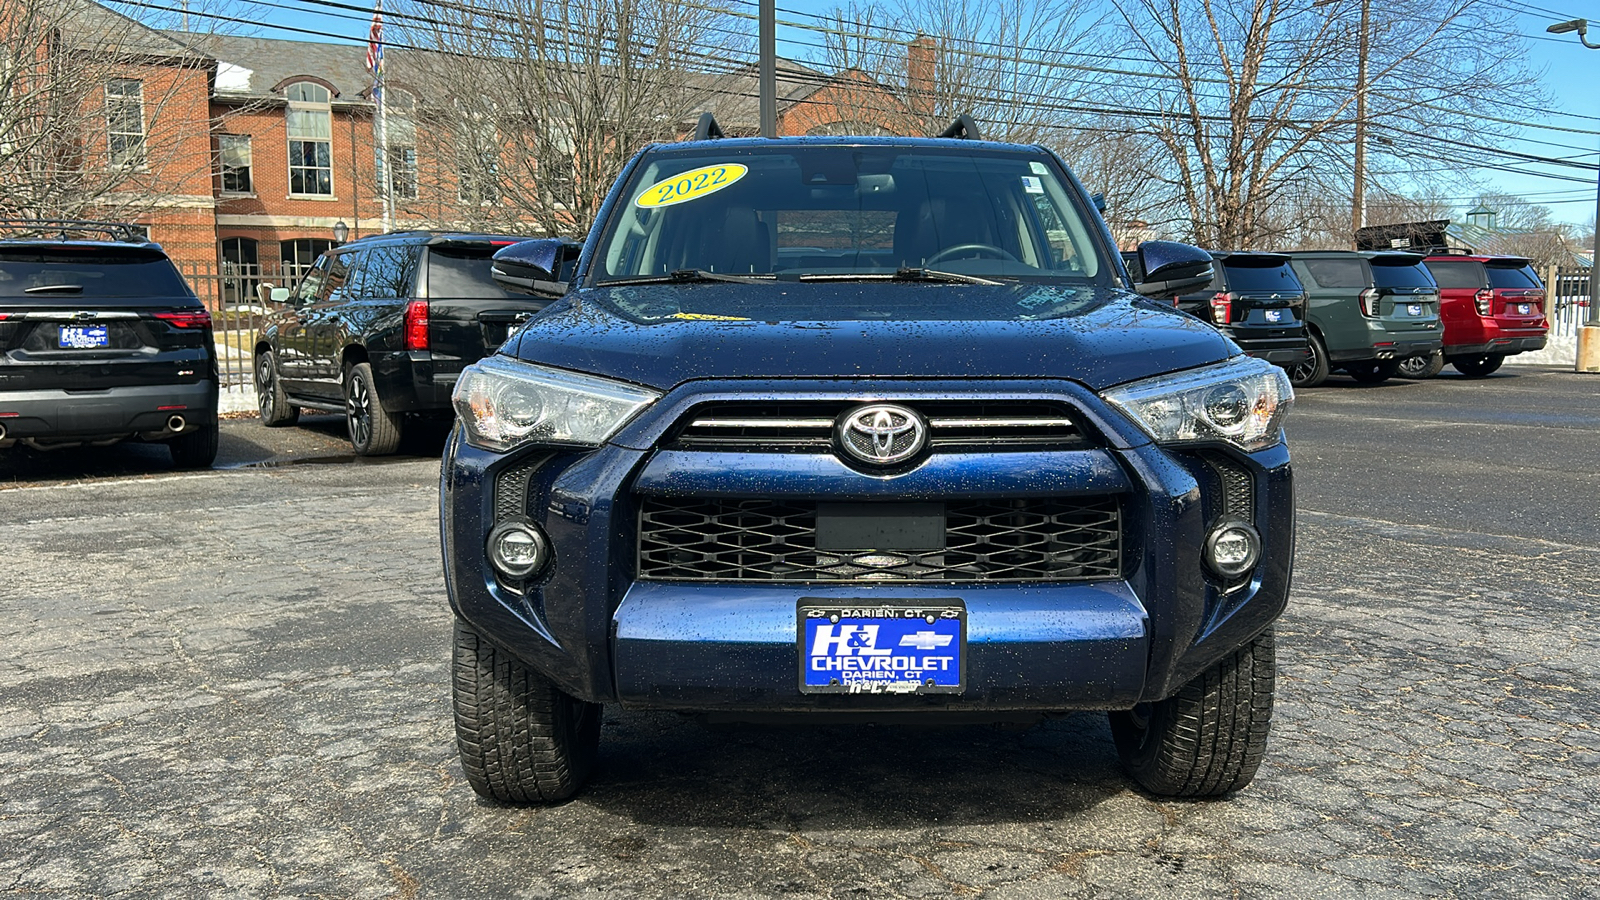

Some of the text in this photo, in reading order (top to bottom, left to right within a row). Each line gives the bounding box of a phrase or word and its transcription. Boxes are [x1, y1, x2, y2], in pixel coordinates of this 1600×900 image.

[658, 167, 727, 203] 2022
[841, 609, 899, 618] DARIEN,
[811, 624, 893, 656] H&L
[811, 656, 954, 671] CHEVROLET
[842, 671, 898, 679] DARIEN,
